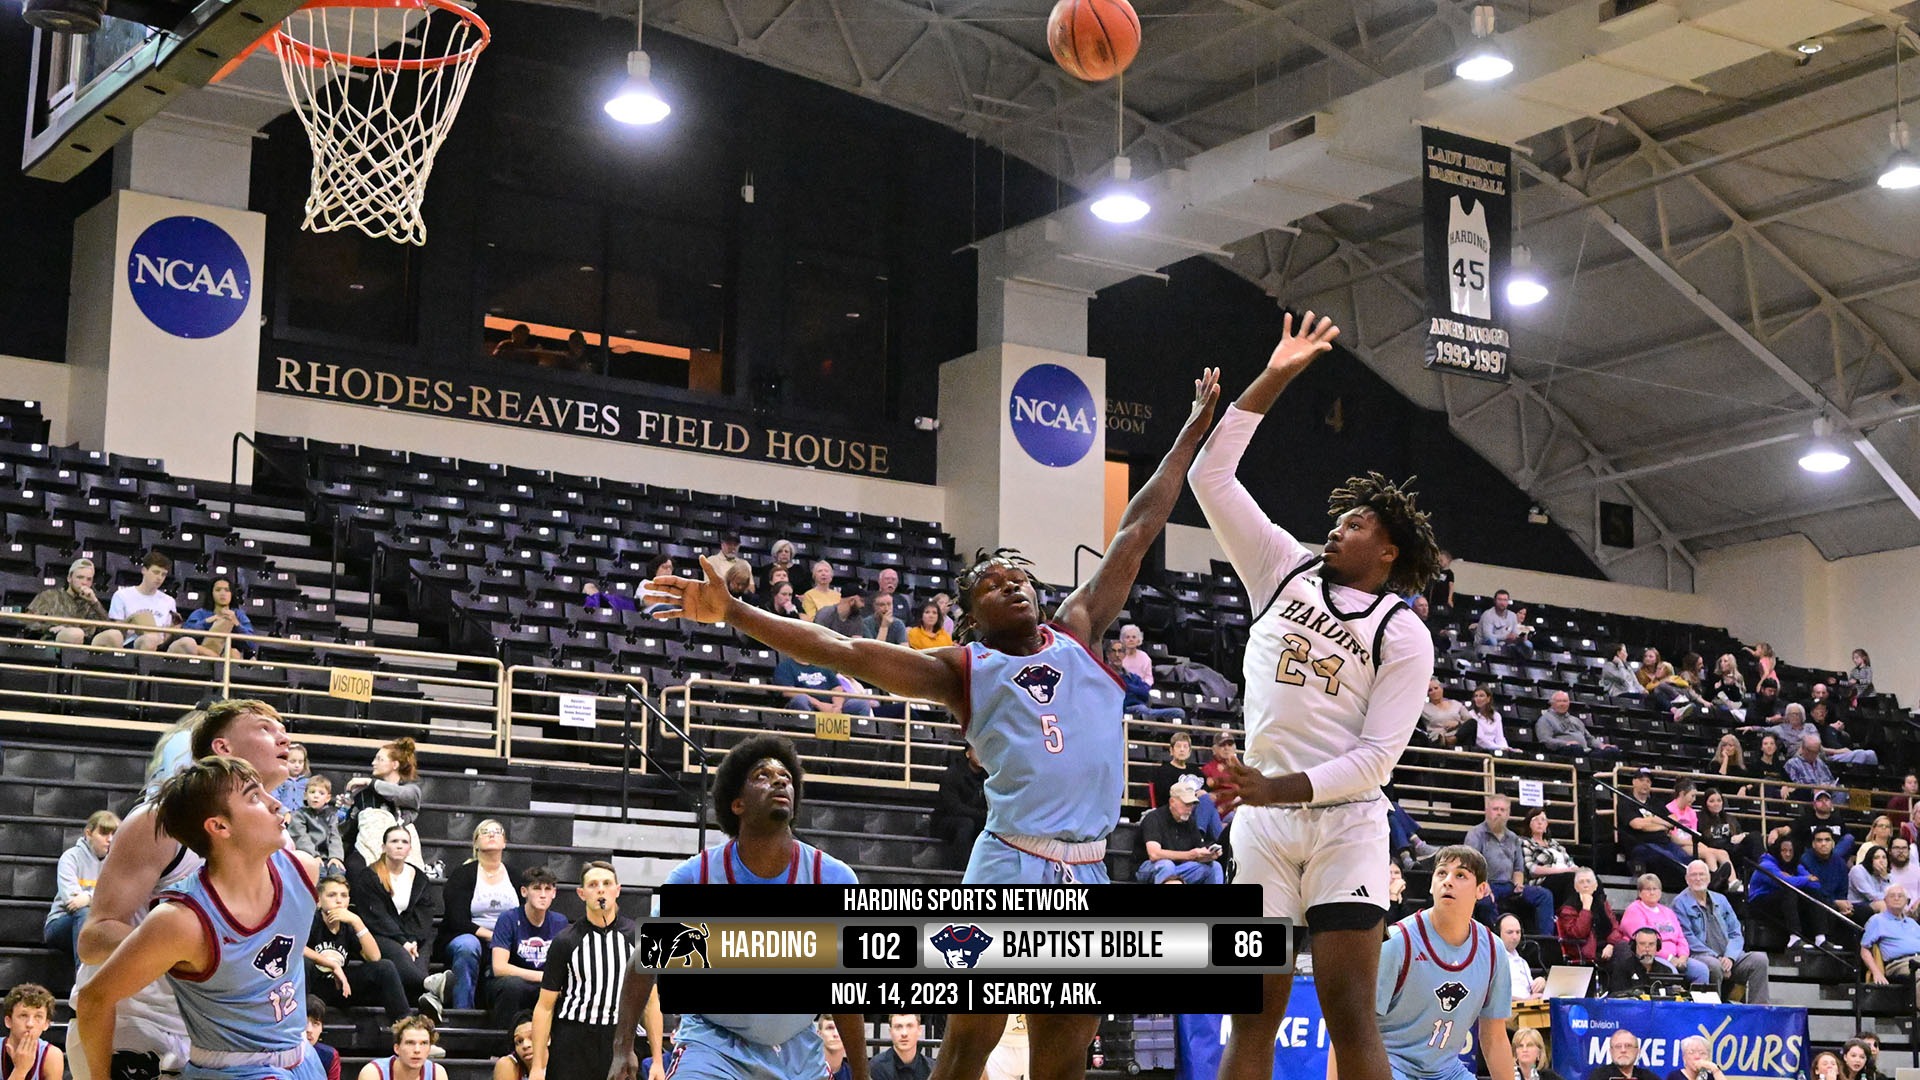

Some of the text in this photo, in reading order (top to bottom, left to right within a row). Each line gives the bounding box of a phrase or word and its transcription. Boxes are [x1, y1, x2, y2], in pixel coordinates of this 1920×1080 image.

[1428, 166, 1506, 195] BASKETBALL
[135, 252, 243, 300] NCAA
[1452, 258, 1485, 291] 45
[1435, 341, 1507, 375] 1993-1997
[275, 356, 889, 474] RHODES-REAVES FIELD HOUSE
[1014, 395, 1092, 434] NCAA
[1105, 399, 1153, 419] EAVES
[1278, 599, 1371, 666] HARDING
[1275, 632, 1346, 696] 24
[333, 673, 371, 696] VISITOR
[817, 717, 849, 735] HOME
[1040, 713, 1064, 754] 5
[268, 981, 298, 1023] 12
[1427, 1018, 1454, 1049] 11
[1590, 1020, 1615, 1029] Division
[1588, 1036, 1667, 1067] MKE
[1698, 1015, 1803, 1075] YOURS
